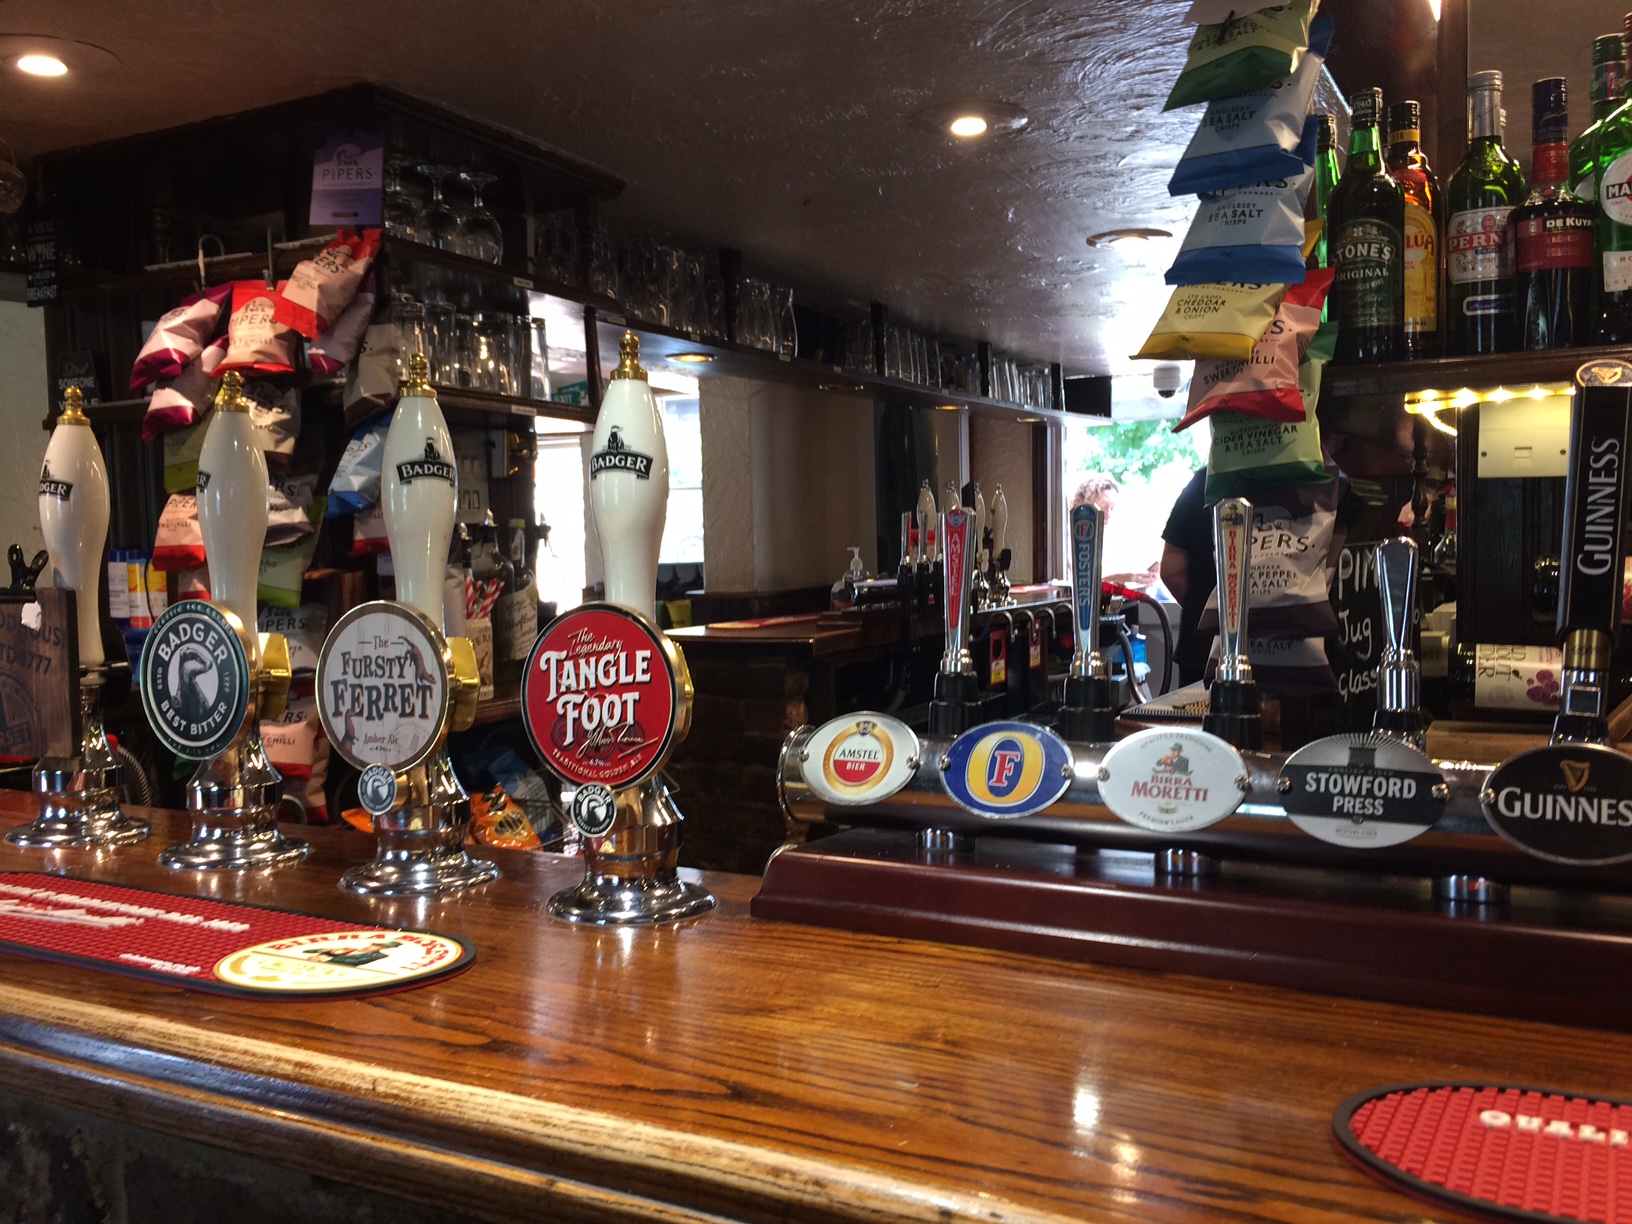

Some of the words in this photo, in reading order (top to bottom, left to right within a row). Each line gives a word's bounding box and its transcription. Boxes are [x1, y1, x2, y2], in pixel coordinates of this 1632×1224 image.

[1203, 115, 1224, 127] SEA
[1227, 111, 1256, 121] SALT
[322, 167, 373, 181] PIPERS
[1208, 212, 1228, 223] SEA
[1231, 209, 1264, 218] SALT
[1218, 203, 1257, 211] ANGLESEY
[1220, 219, 1246, 227] CRISPS
[1546, 219, 1564, 228] DE
[1406, 228, 1435, 257] LÚA
[1449, 233, 1503, 251] PERN
[1331, 243, 1392, 266] STONE'S
[1184, 306, 1220, 314] ONION
[58, 376, 95, 390] SOMEONE
[1214, 434, 1244, 446] CIDER
[1247, 425, 1298, 439] VINEGAR
[1234, 441, 1254, 452] SEA
[1257, 436, 1283, 446] SALT
[1242, 448, 1266, 456] CRISPS
[401, 463, 455, 480] BADGER
[591, 455, 648, 471] BADGER
[40, 482, 67, 495] DGER
[1577, 437, 1620, 575] GUINNESS
[1228, 530, 1237, 569] BIRRA
[949, 532, 961, 597] AMSTEL
[1259, 571, 1298, 581] PEPPER
[1262, 579, 1289, 589] SALT
[1227, 573, 1238, 629] MORETTI
[260, 618, 307, 632] IPERS
[157, 622, 228, 665] BADGER
[374, 635, 389, 650] The
[569, 627, 595, 644] The
[1338, 609, 1372, 661] Jug
[569, 637, 624, 660] Legendary
[341, 651, 412, 680] FURSTY
[540, 649, 652, 702] TANGLE
[331, 678, 434, 722] FERRET
[160, 700, 188, 732] BEST
[190, 701, 228, 735] BITTER
[556, 691, 640, 746] FOOT
[364, 733, 386, 746] Amber
[387, 734, 399, 746] Ale
[839, 748, 880, 760] AMSTEL
[552, 748, 598, 778] TRADITIONAL
[599, 763, 629, 779] GOLDEN
[630, 753, 643, 768] ALE
[846, 761, 866, 771] BIER
[989, 751, 1020, 787] F
[363, 766, 393, 784] BADGER
[1150, 775, 1193, 787] BIRRA
[577, 785, 612, 804] BADGER
[1130, 781, 1209, 802] MORETTI
[1305, 772, 1417, 799] STOWFORD
[1333, 796, 1384, 816] PRESS
[1497, 786, 1632, 827] GUINNES
[1138, 810, 1170, 826] PREMIUM
[1171, 815, 1194, 825] LAGER
